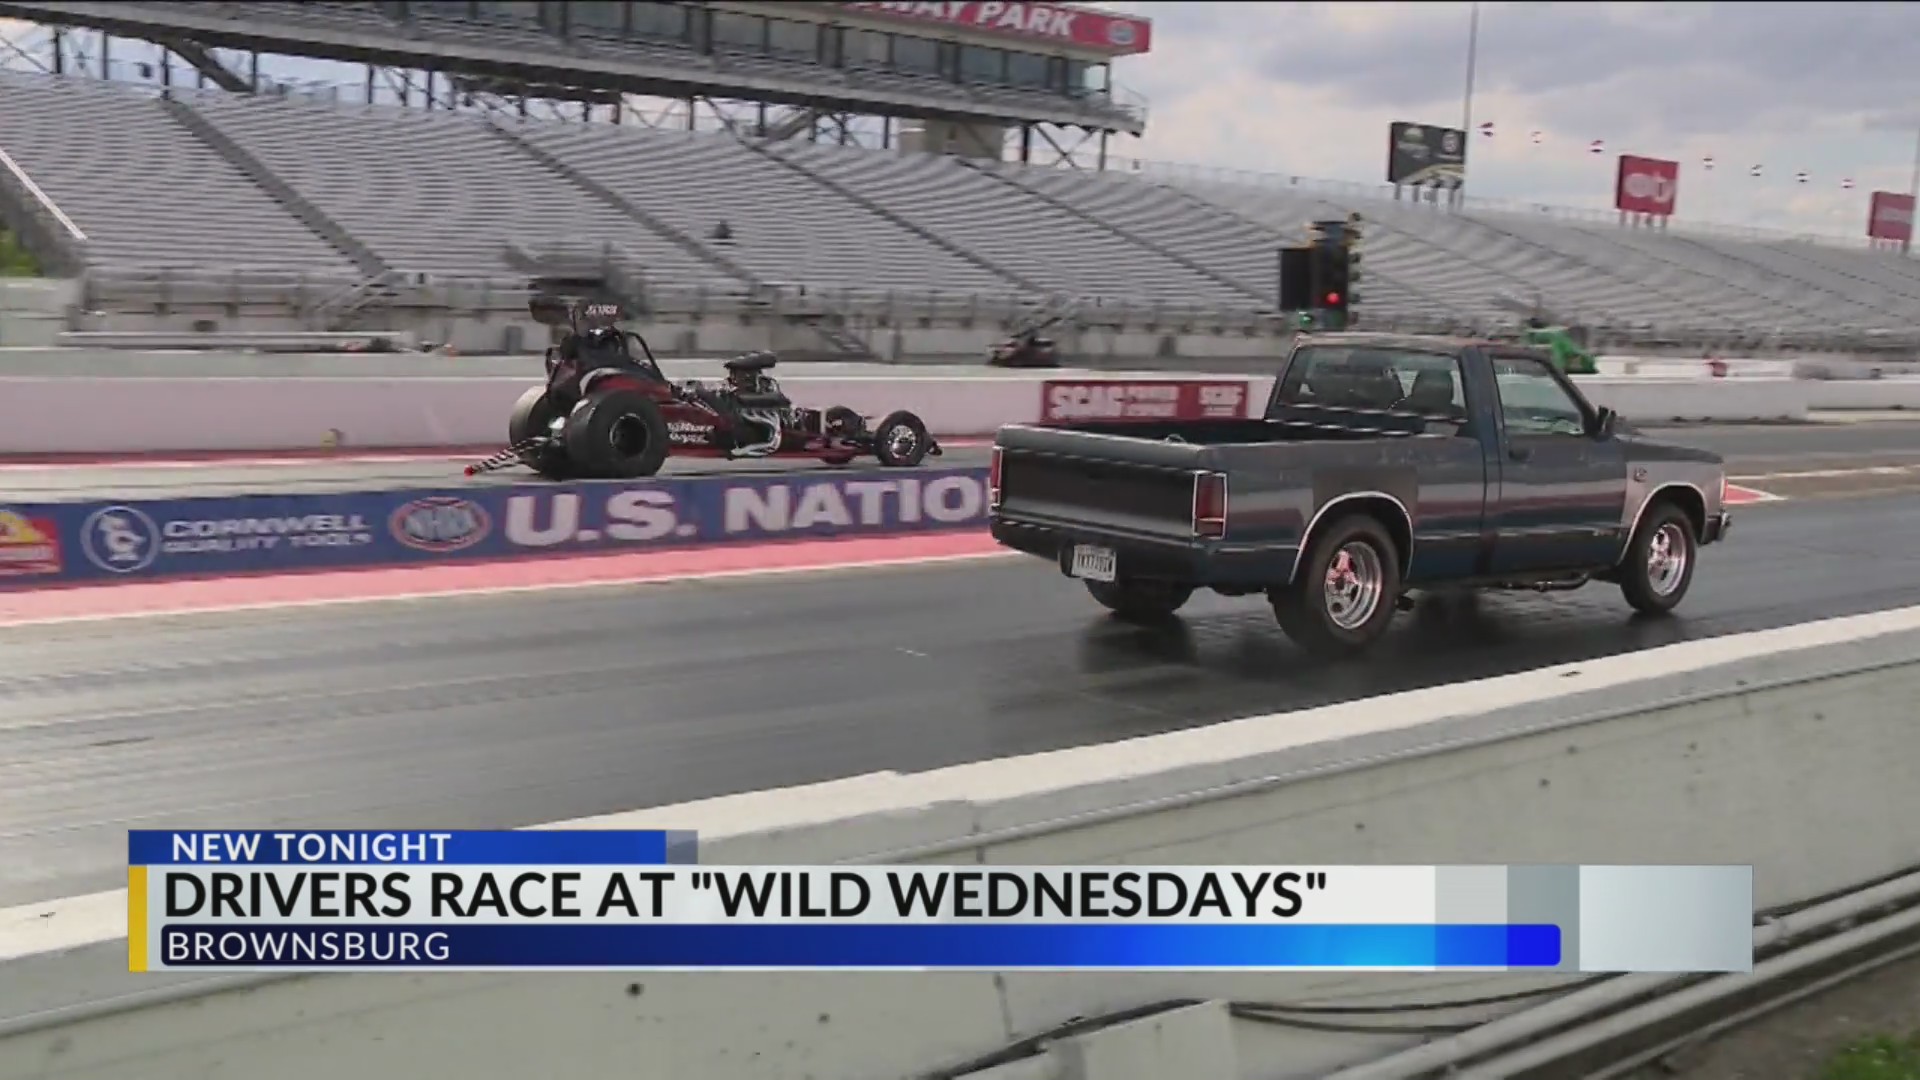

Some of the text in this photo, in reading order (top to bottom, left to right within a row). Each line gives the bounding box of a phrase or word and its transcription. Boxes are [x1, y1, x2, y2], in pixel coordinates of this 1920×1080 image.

[976, 3, 1077, 37] PARK
[163, 514, 373, 538] CORNWELL
[505, 475, 992, 547] U.S. NATIO
